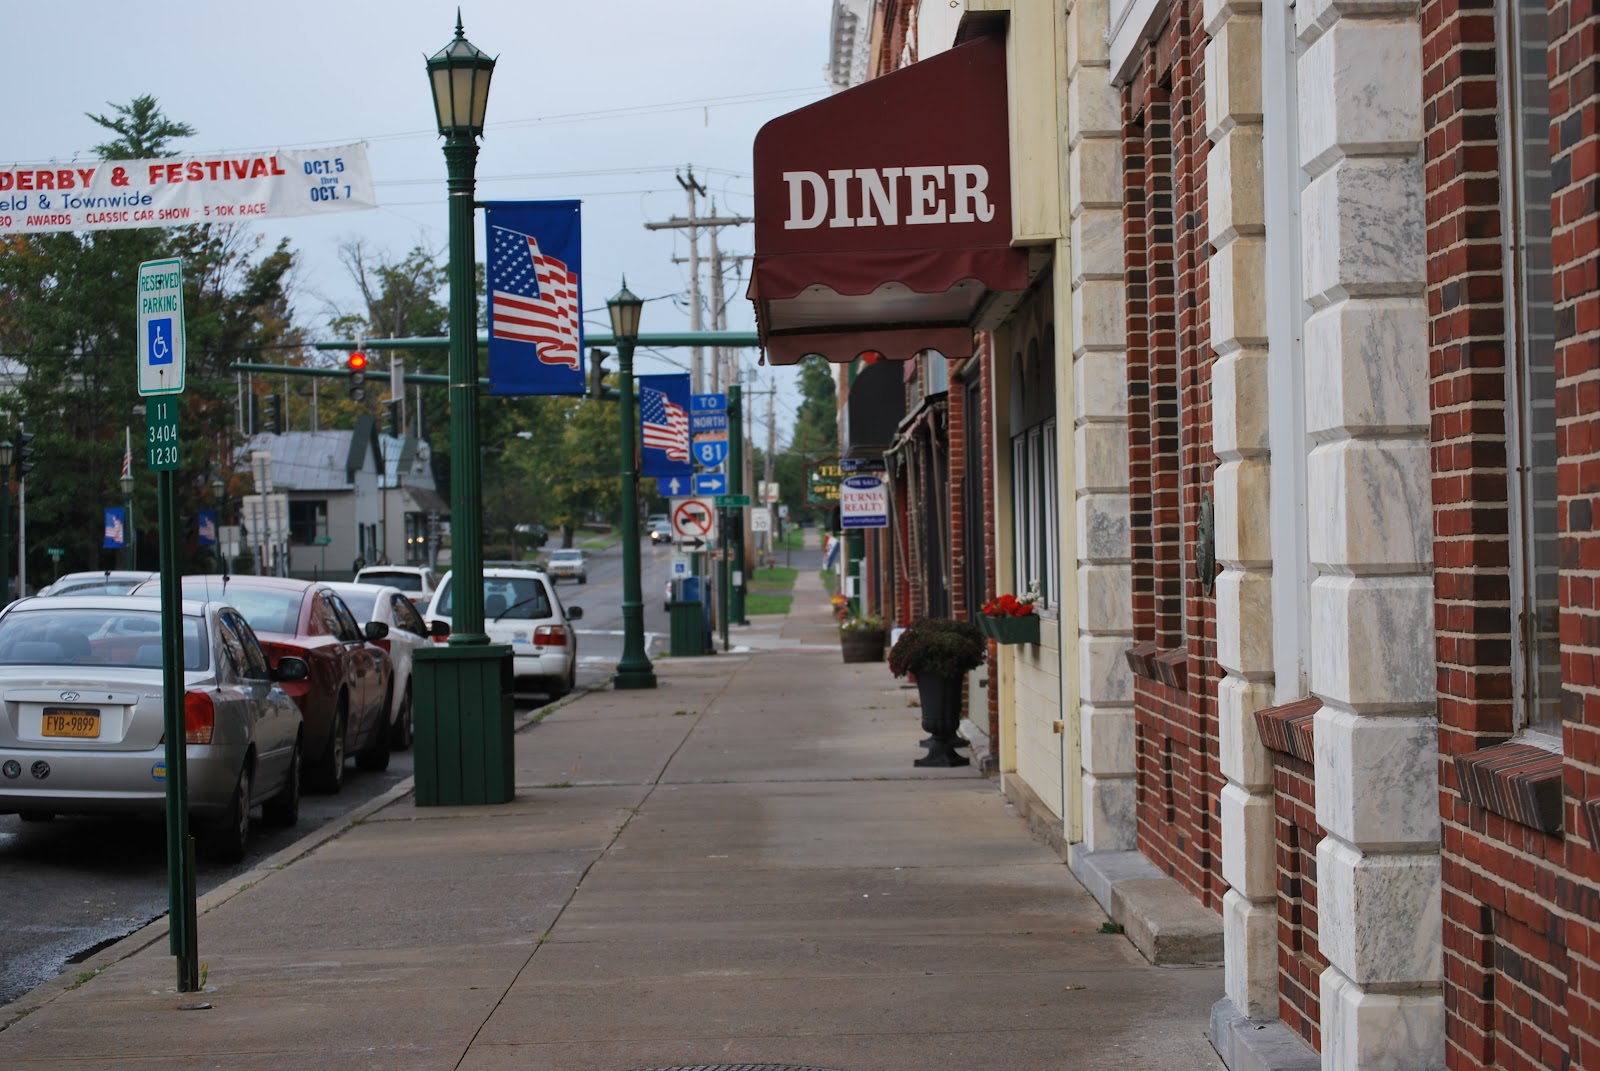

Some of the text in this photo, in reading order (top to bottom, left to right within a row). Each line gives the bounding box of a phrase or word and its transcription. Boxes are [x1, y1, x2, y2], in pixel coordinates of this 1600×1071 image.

[0, 156, 285, 191] DERBY & FESTIVAL
[304, 158, 345, 175] OCT. 5
[0, 191, 153, 211] eld & Townwide
[310, 185, 351, 202] OCT. 7
[783, 164, 995, 230] DINER
[26, 214, 72, 226] AWARDS
[86, 211, 129, 223] CLASSIC
[133, 210, 154, 221] CAR
[159, 208, 190, 220] SHOW
[239, 203, 267, 215] RACE
[141, 272, 179, 292] RESERVED
[143, 294, 177, 314] PARKING
[157, 403, 167, 420] 11
[700, 397, 717, 408] TO
[693, 416, 725, 428] NORTH
[149, 423, 177, 443] 3404
[151, 446, 178, 465] 1230
[701, 444, 722, 462] 81
[843, 492, 884, 502] FURNIA
[844, 502, 884, 512] REALTY
